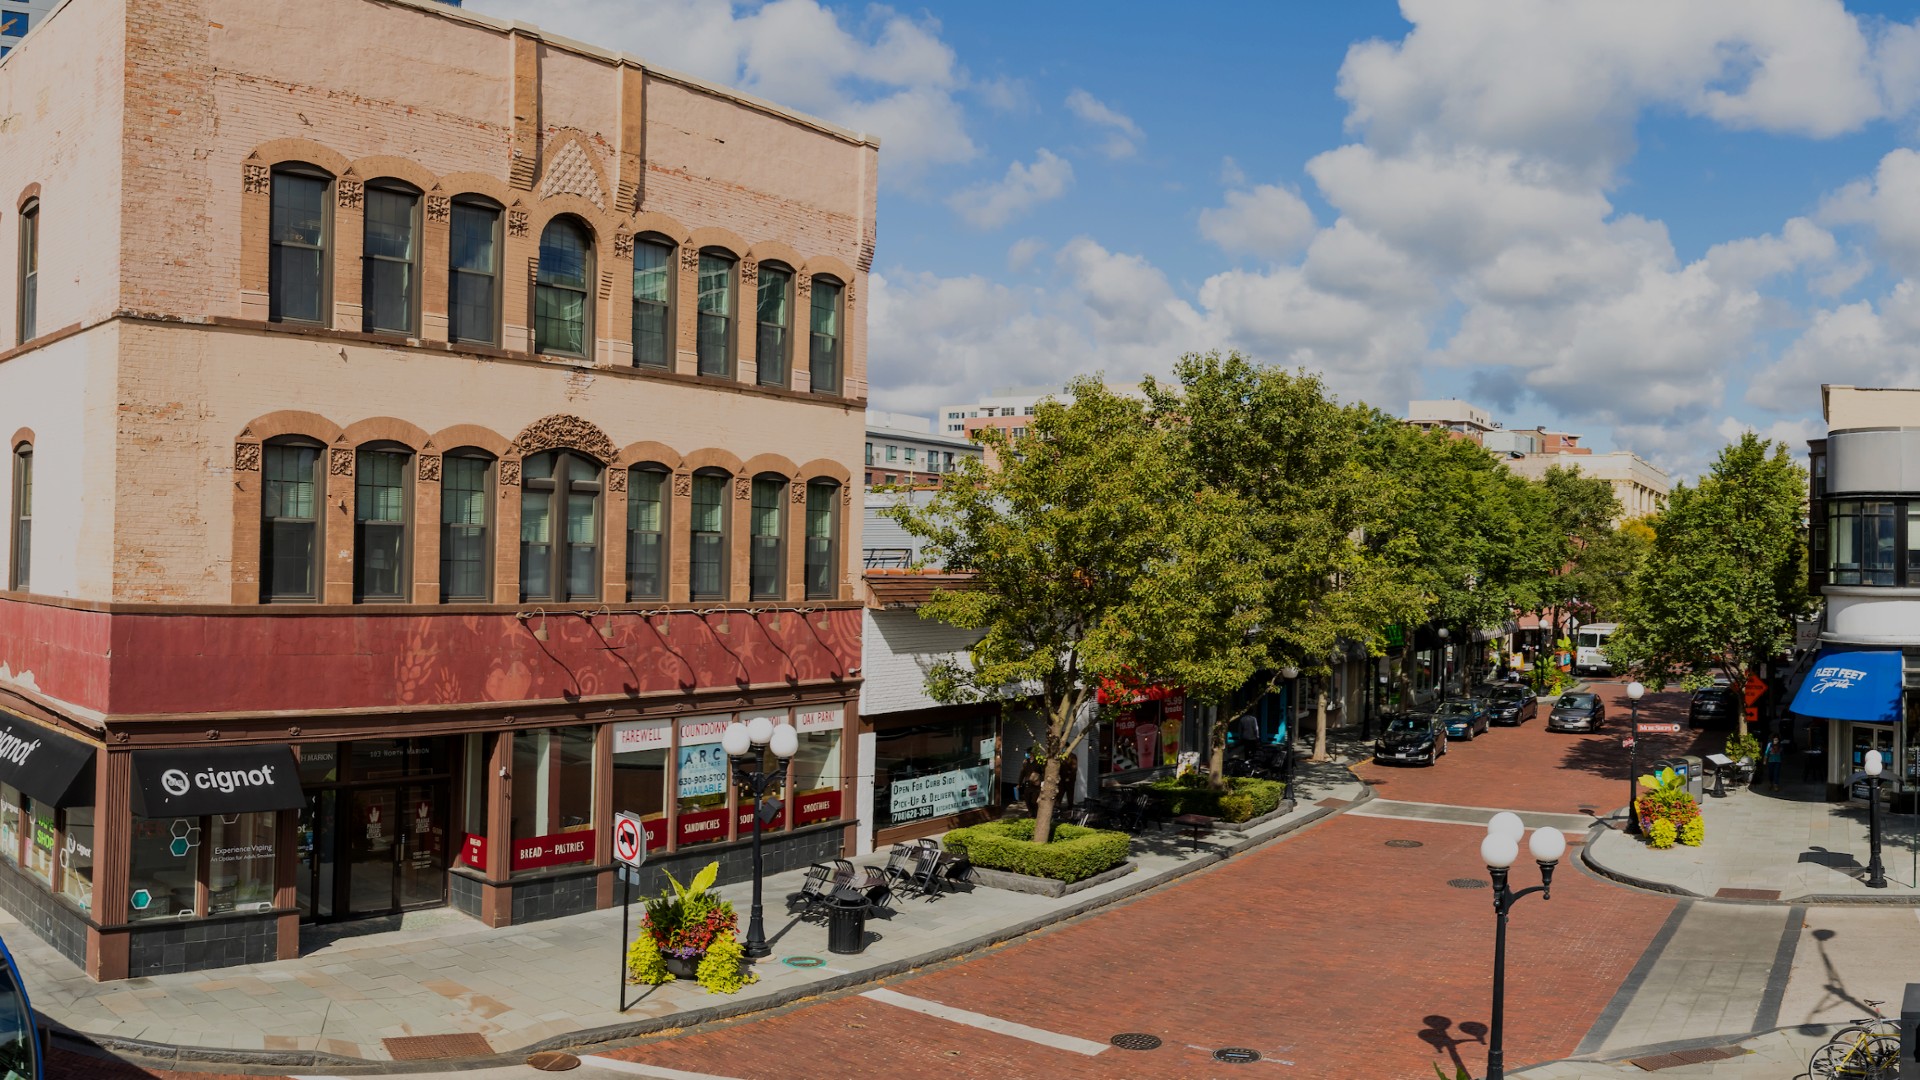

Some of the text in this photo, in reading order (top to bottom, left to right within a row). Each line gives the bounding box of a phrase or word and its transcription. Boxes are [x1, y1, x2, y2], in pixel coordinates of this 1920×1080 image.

[1814, 667, 1867, 681] FLEET FEET
[1811, 677, 1854, 694] Sports
[803, 714, 815, 725] OAK
[622, 728, 662, 744] FAREWELL
[0, 726, 40, 766] ignot
[308, 753, 334, 761] MARION
[194, 765, 275, 794] cignot
[682, 783, 722, 797] AVAILABLE
[921, 794, 927, 804] &
[803, 800, 830, 814] SMOOTHIES
[684, 818, 720, 834] SANDWICHES
[37, 829, 54, 850] SHOP
[214, 846, 251, 856] Experience
[519, 846, 543, 860] BREAD
[554, 840, 585, 856] PASTRIES
